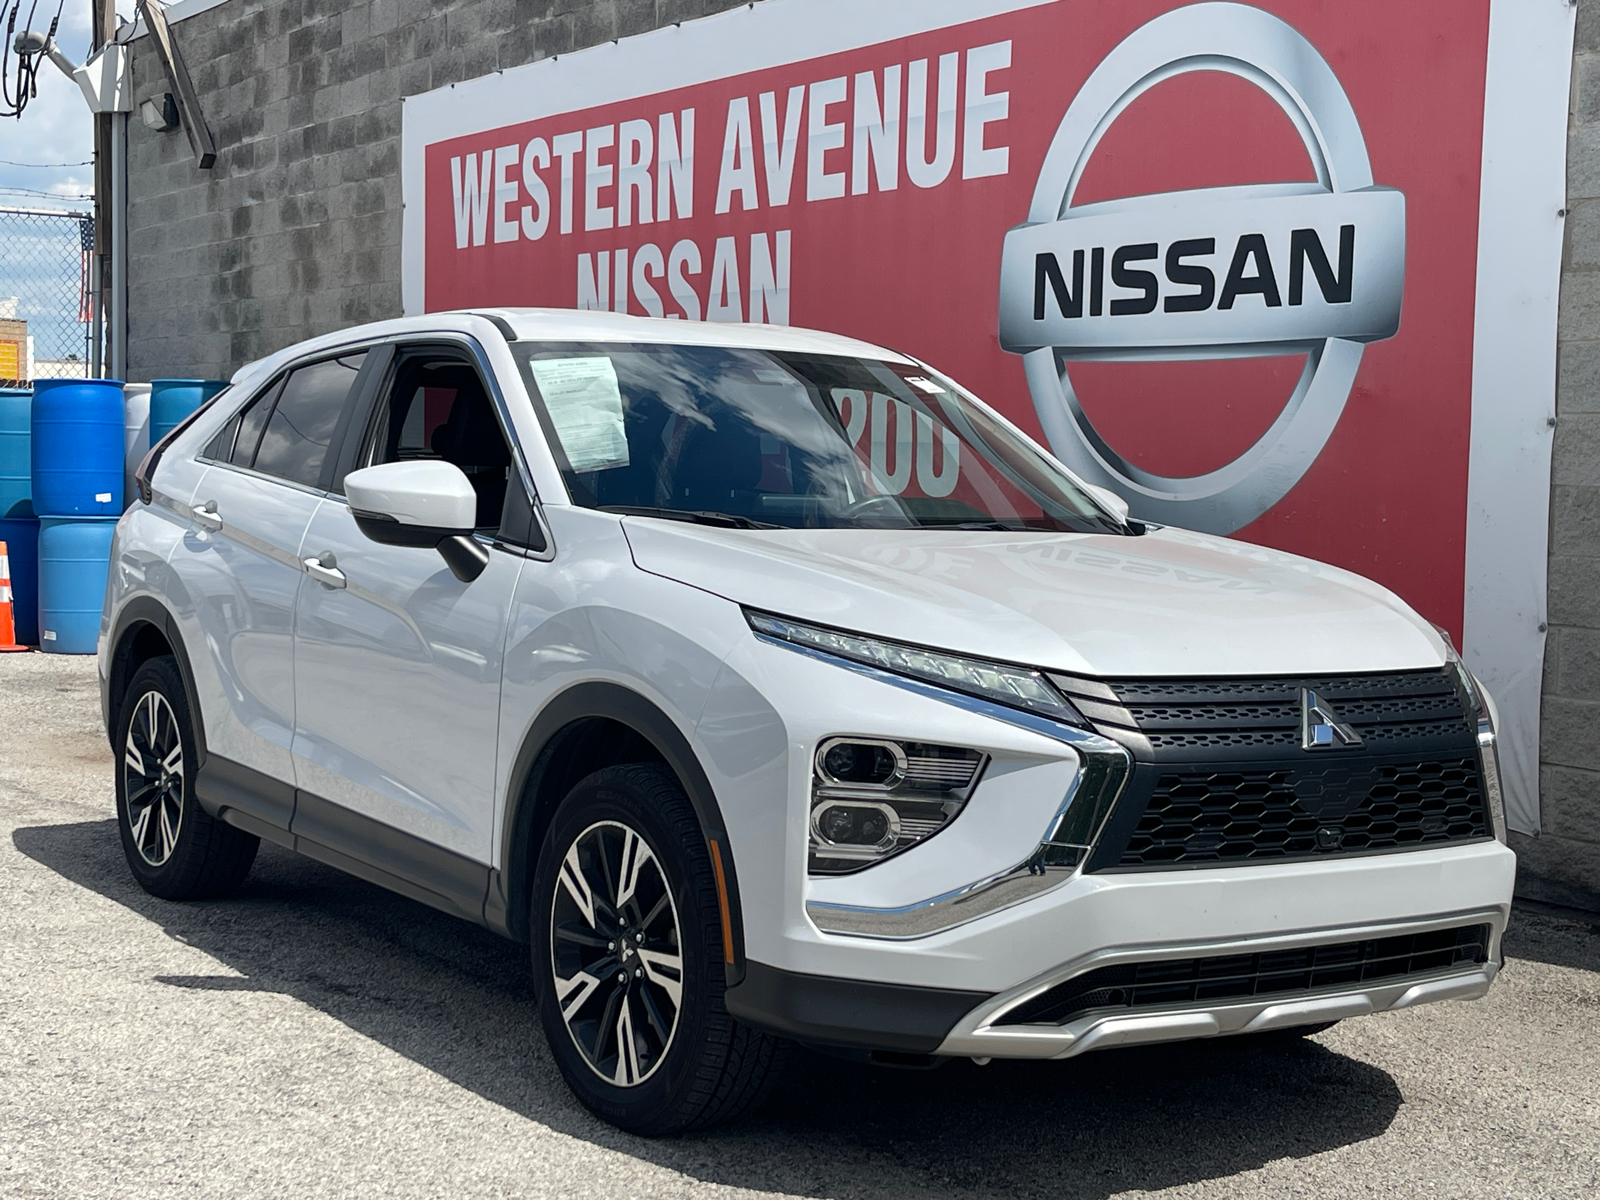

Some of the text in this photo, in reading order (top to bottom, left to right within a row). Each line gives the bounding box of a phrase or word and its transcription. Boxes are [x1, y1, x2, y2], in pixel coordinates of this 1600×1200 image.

[450, 39, 1012, 250] WESTERN AVENUE
[577, 229, 792, 326] NISSAN
[1033, 224, 1355, 320] NISSAN
